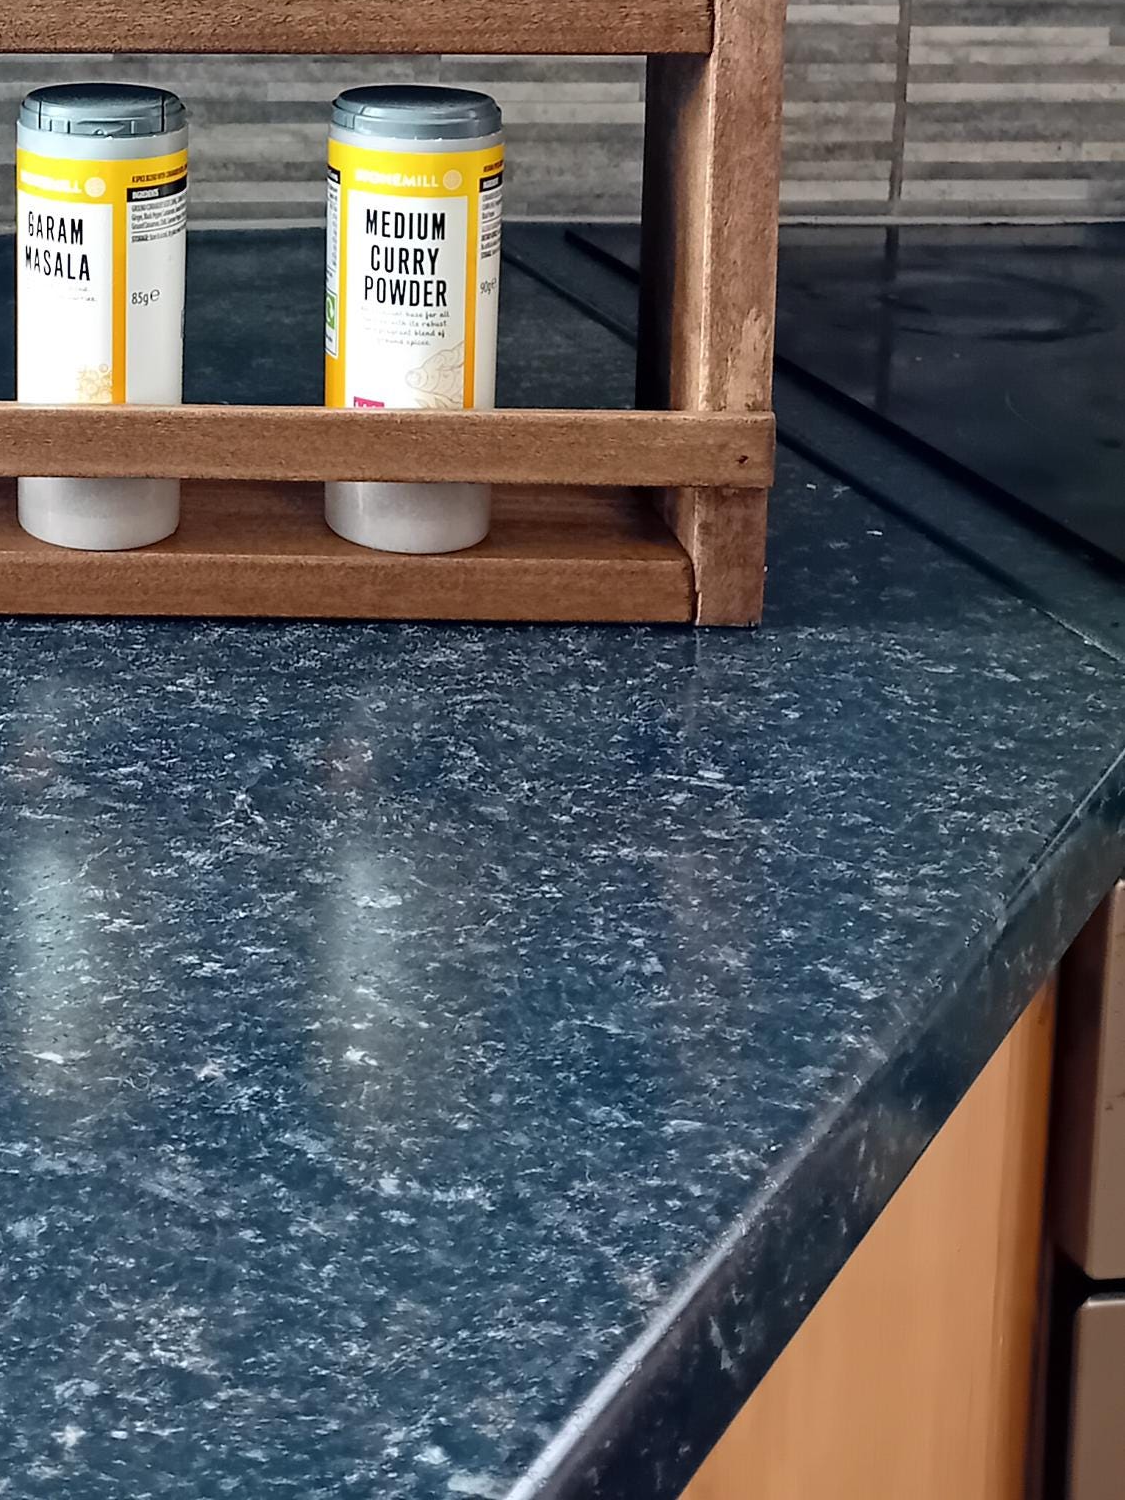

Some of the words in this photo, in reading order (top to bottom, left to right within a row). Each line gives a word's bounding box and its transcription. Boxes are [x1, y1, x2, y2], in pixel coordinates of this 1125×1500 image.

[28, 211, 84, 245] GARAM
[365, 208, 447, 241] MEDIUM
[25, 245, 91, 281] MASALA
[370, 244, 440, 276] CURRY
[363, 275, 448, 307] POWDER
